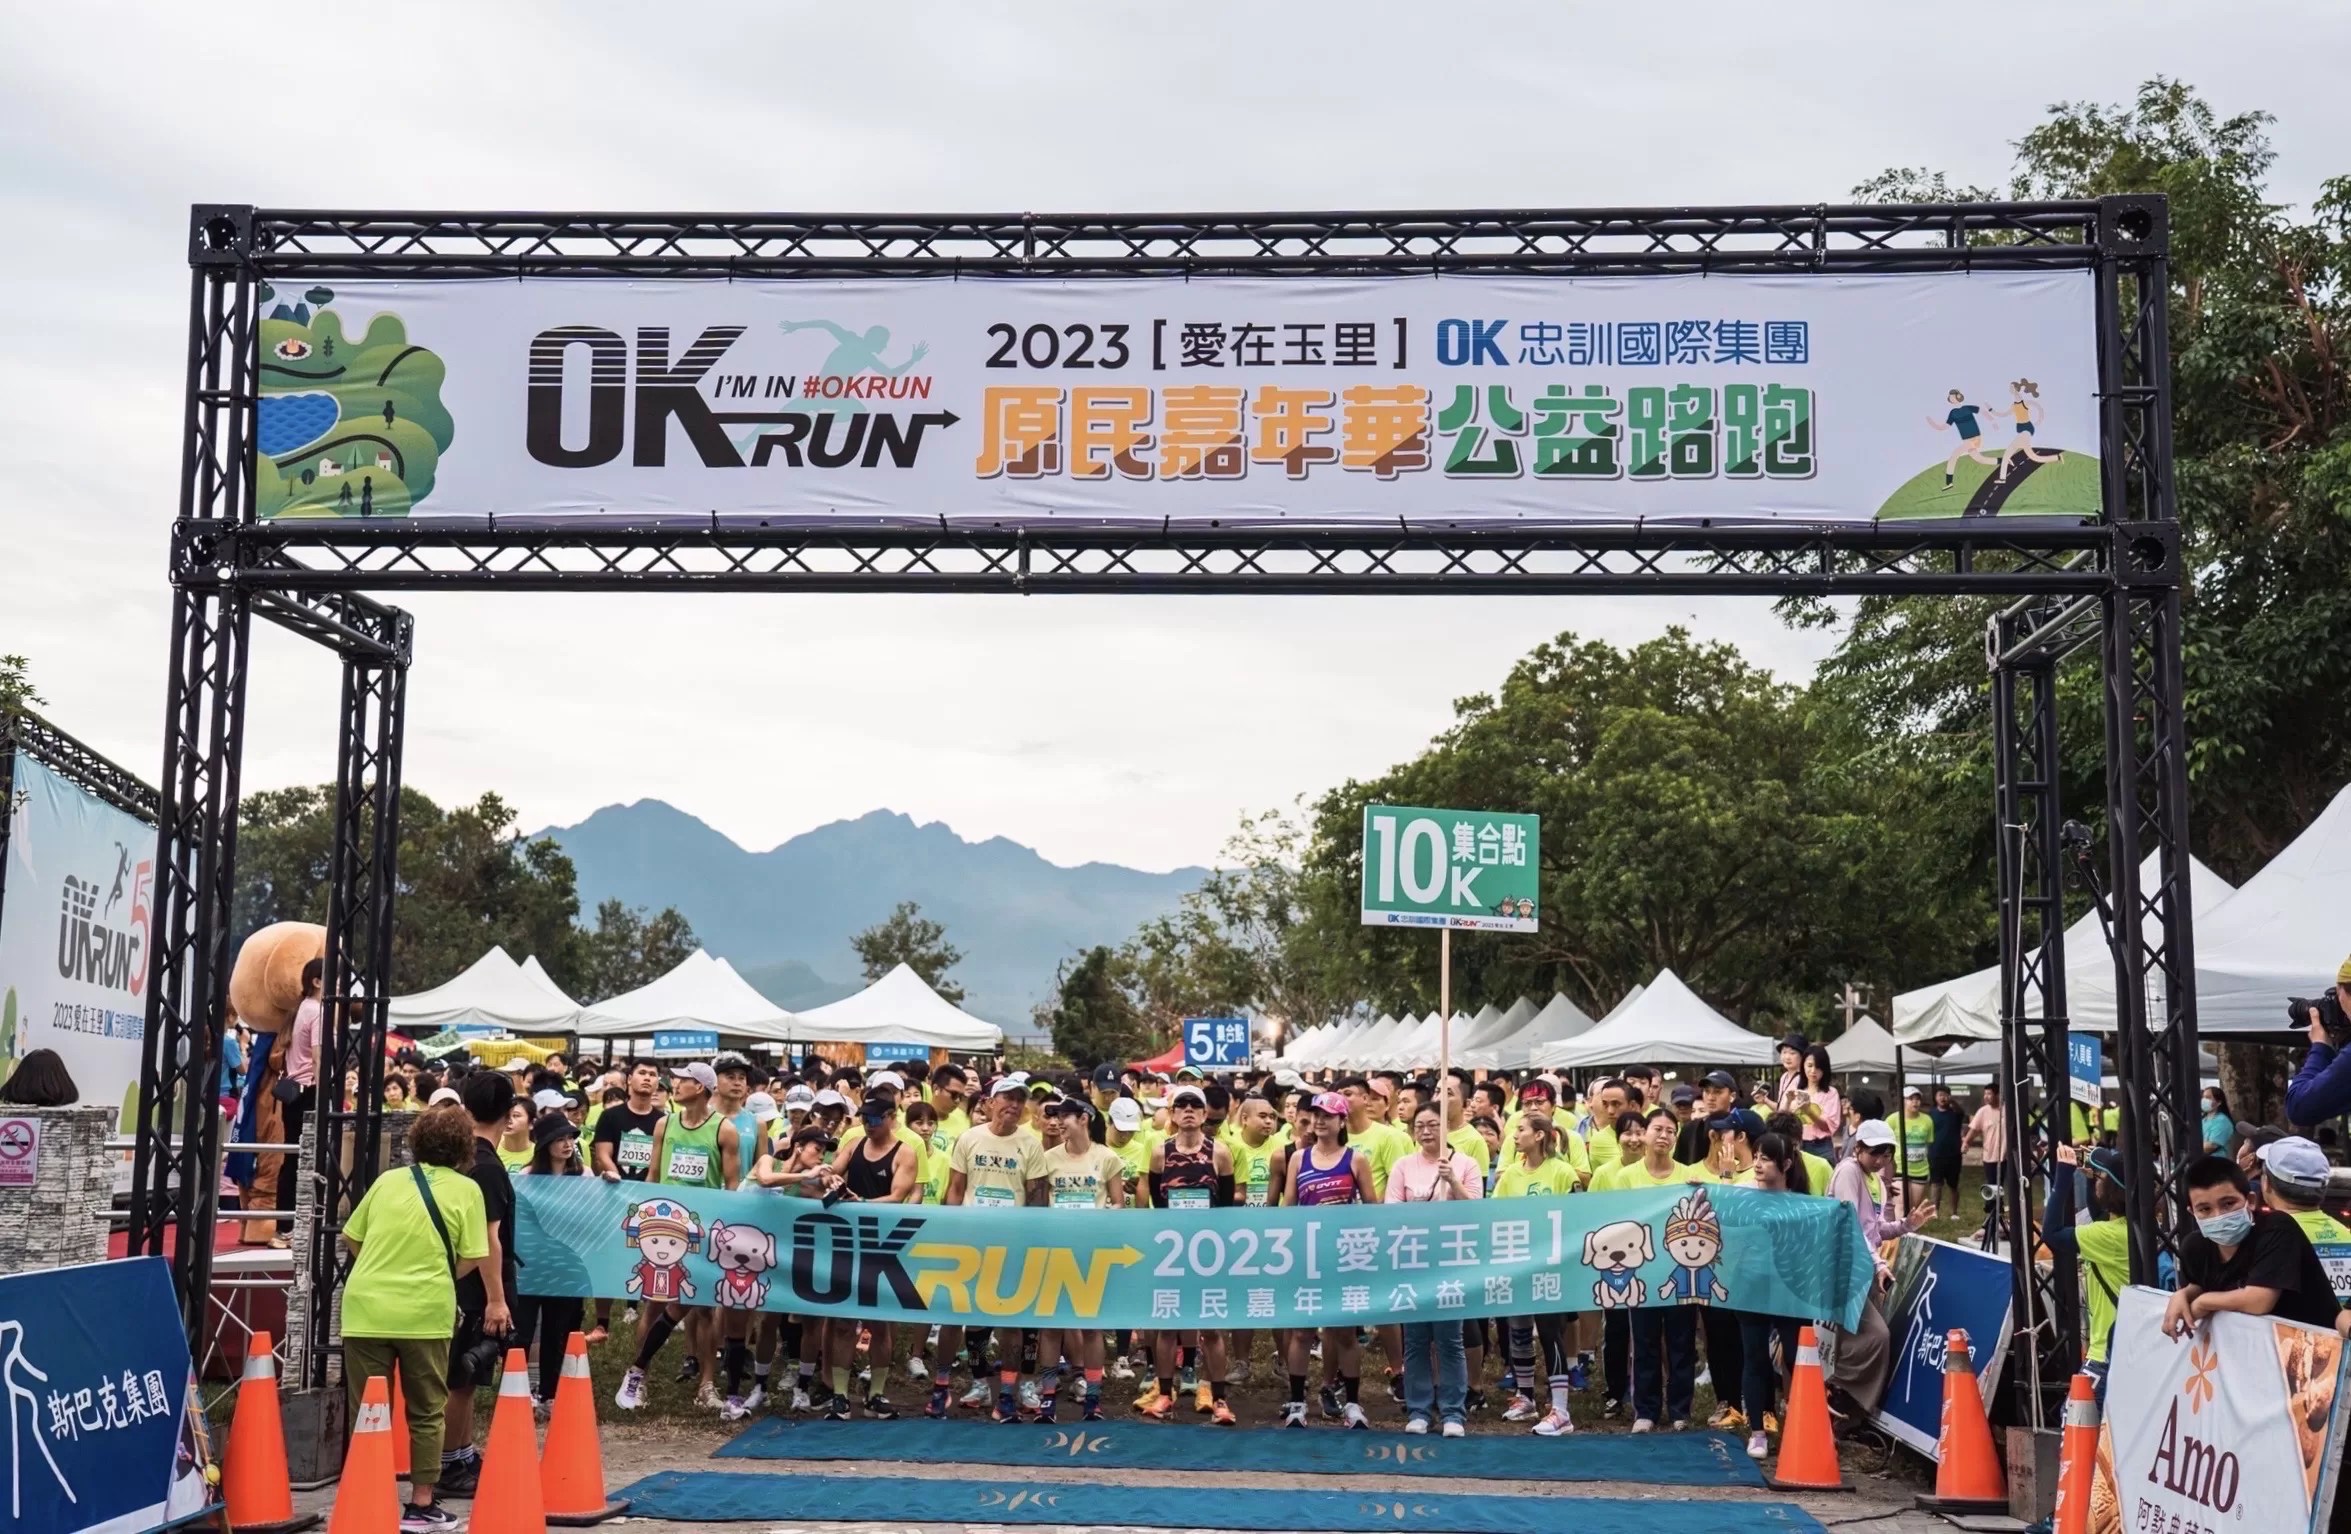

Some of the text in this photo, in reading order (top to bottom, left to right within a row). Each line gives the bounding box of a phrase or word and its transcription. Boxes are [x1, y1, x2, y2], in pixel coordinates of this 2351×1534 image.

[985, 322, 1130, 370] 2023
[1436, 319, 1509, 366] OK
[1519, 320, 1810, 365] 忠訓國際集團
[763, 374, 796, 399] IN
[802, 374, 933, 400] #OKRUN
[976, 384, 1819, 481] 原民嘉年華公益路跑
[1452, 821, 1527, 867] 集合點
[53, 1001, 73, 1031] 2023
[74, 1004, 103, 1036] 愛在玉里
[104, 1009, 115, 1037] OK
[1216, 1023, 1245, 1044] 集合點
[621, 1150, 651, 1162] 20130
[671, 1163, 704, 1176] 20239
[1153, 1228, 1295, 1278] 2023
[1151, 1271, 1563, 1319] 原民嘉年華公益路跑
[47, 1368, 172, 1442] 斯巴克集團
[2148, 1394, 2240, 1514] Amo
